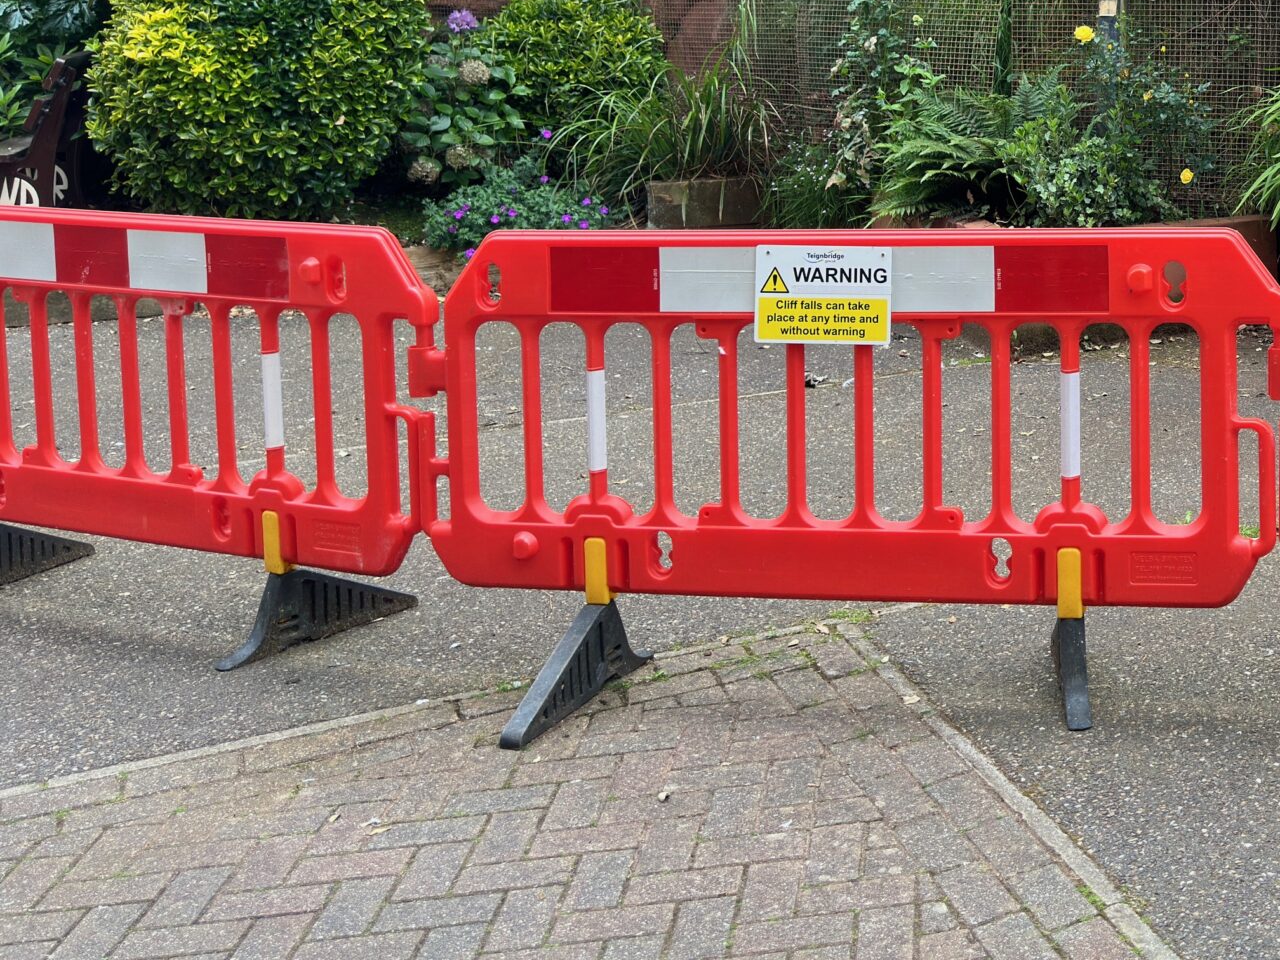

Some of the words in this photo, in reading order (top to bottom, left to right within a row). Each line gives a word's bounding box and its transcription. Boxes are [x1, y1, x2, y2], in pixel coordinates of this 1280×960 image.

[807, 252, 845, 261] Teignbridge
[793, 267, 888, 284] WARNING
[776, 300, 798, 310] Cliff
[800, 300, 823, 310] falls
[825, 302, 845, 310] can
[848, 301, 870, 311] take
[766, 313, 795, 324] place
[798, 314, 808, 322] at
[811, 315, 830, 325] any
[833, 314, 856, 323] time
[859, 314, 879, 324] and
[780, 326, 820, 336] without
[823, 327, 866, 338] warning
